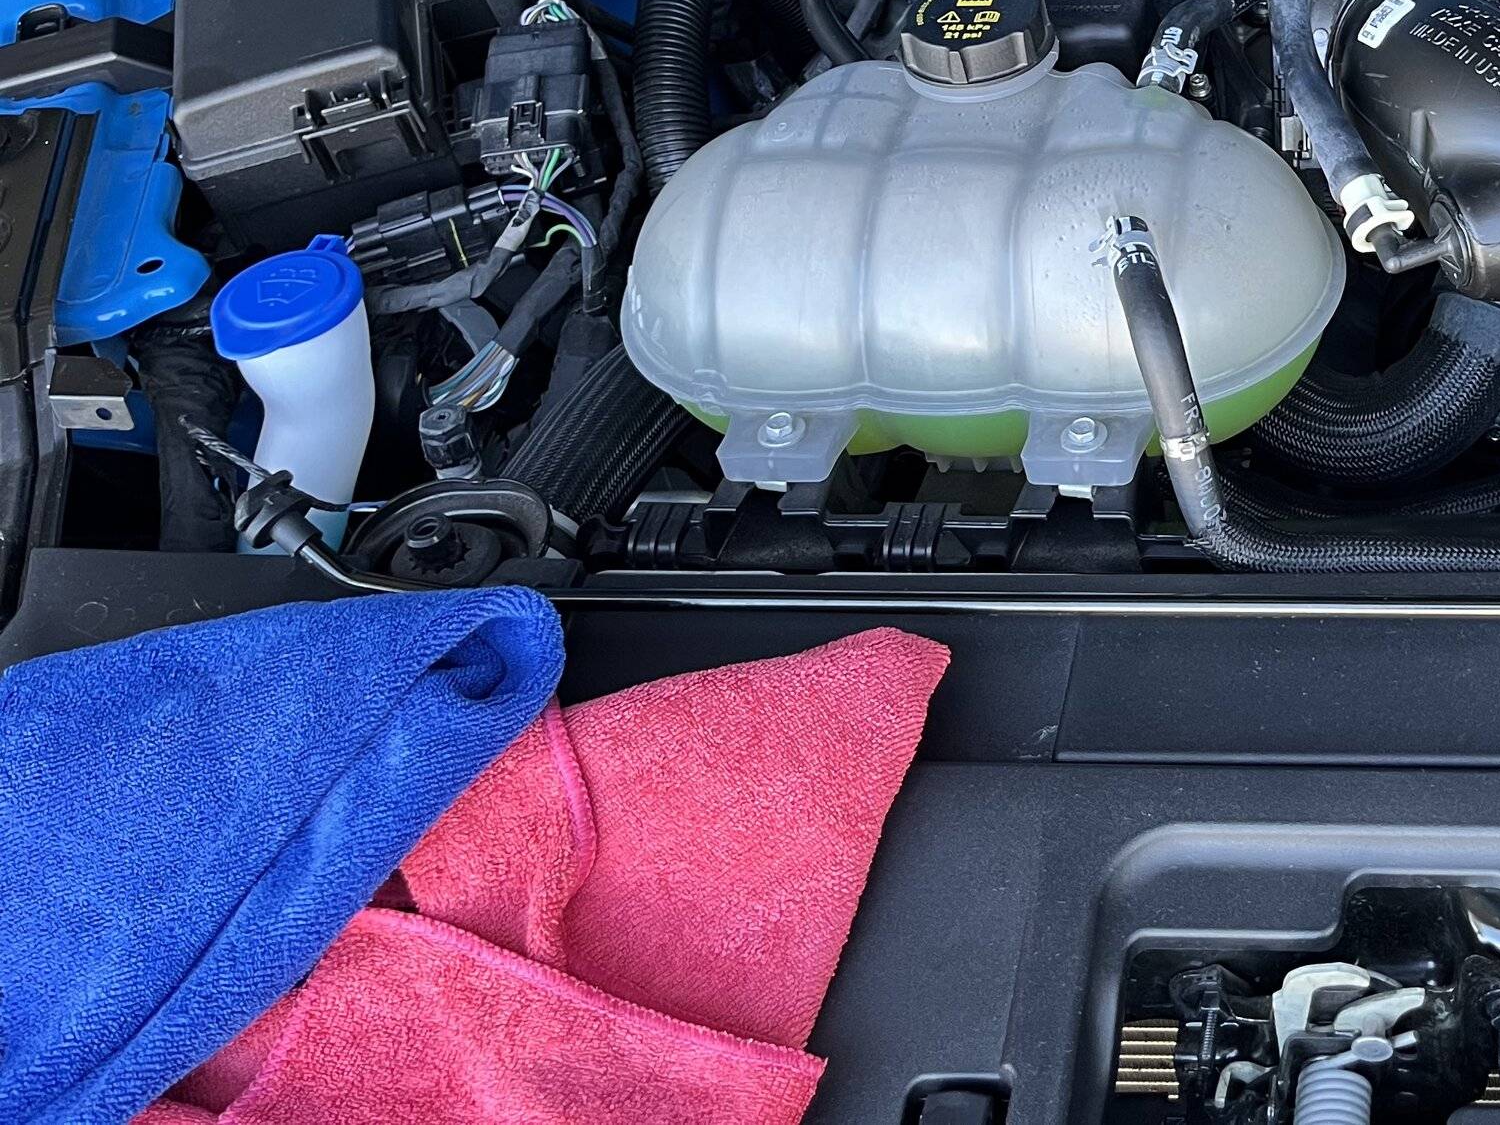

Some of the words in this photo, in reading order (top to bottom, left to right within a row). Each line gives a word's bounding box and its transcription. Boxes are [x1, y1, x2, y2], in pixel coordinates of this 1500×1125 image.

[943, 32, 960, 40] 21
[962, 31, 983, 40] psi
[1409, 24, 1460, 53] MADE
[1455, 44, 1479, 65] IN
